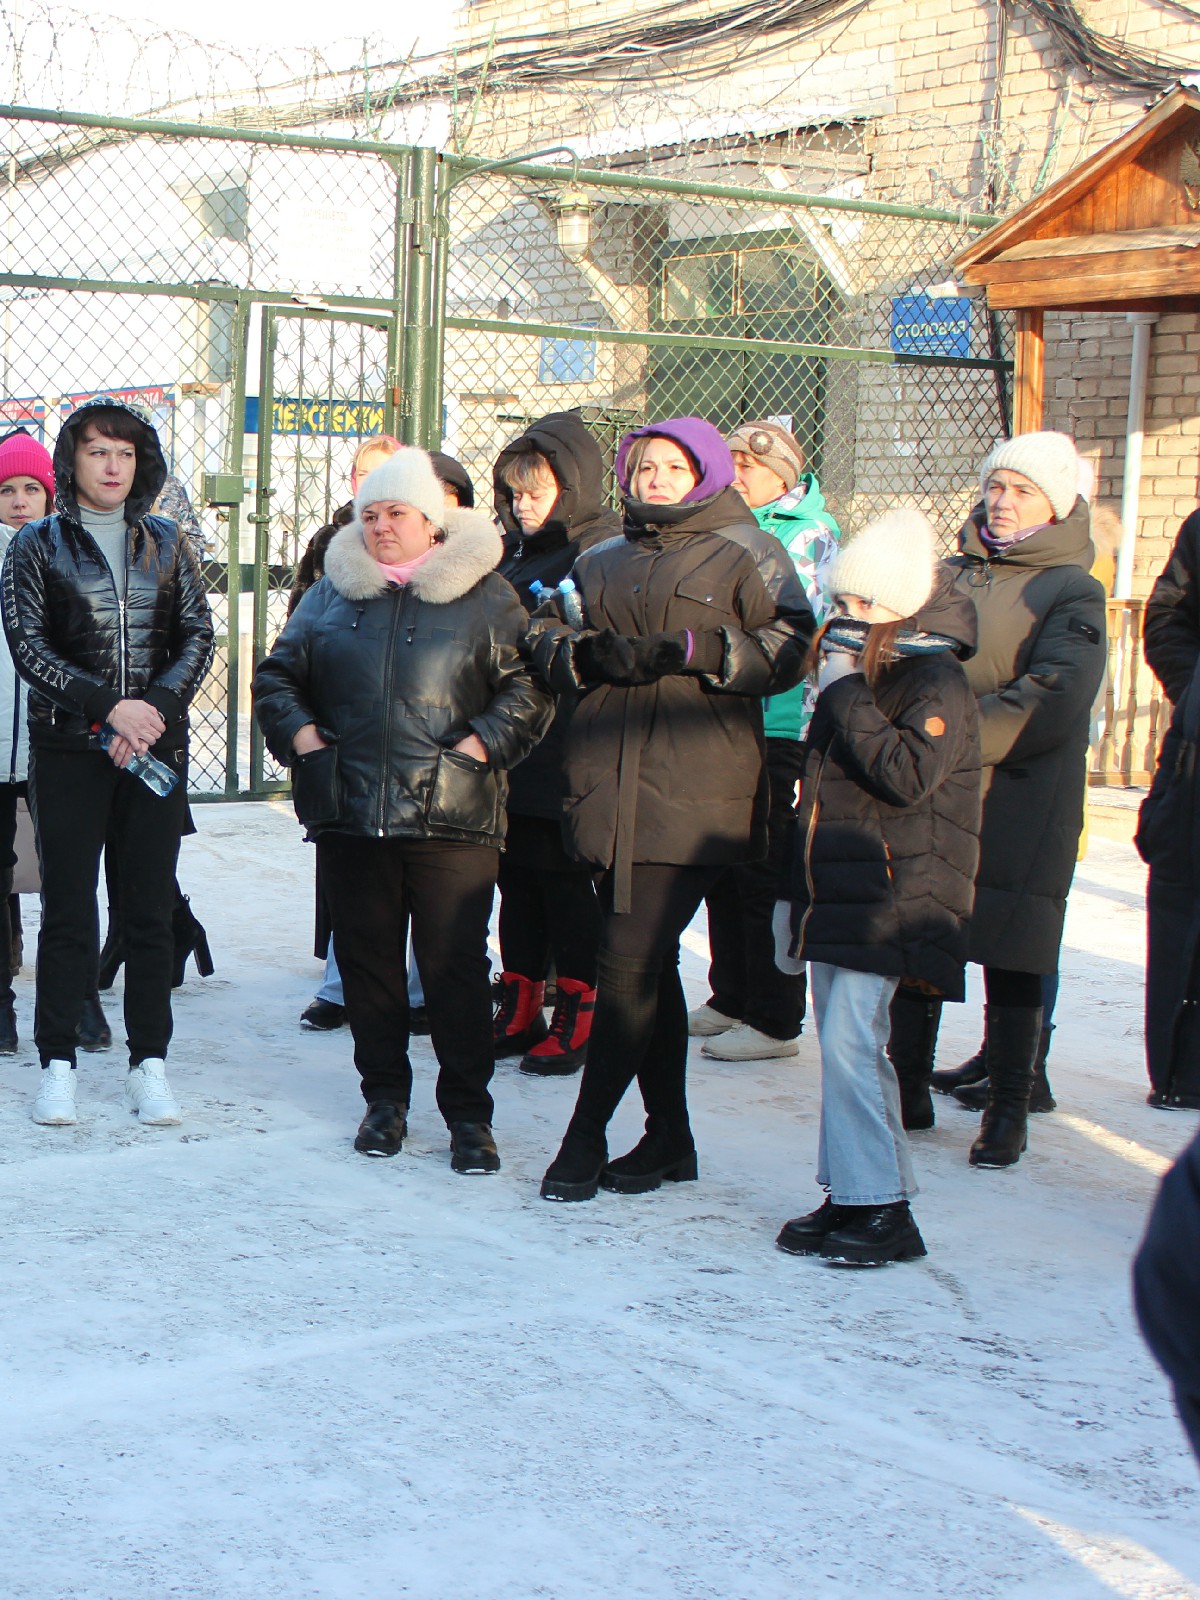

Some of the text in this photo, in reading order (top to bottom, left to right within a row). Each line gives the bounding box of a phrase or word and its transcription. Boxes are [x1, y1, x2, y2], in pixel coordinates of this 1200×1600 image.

[894, 320, 966, 338] СТОЛОВАЯ
[272, 403, 384, 433] ПЕРСПЕКТИ
[15, 640, 75, 691] PLEIN
